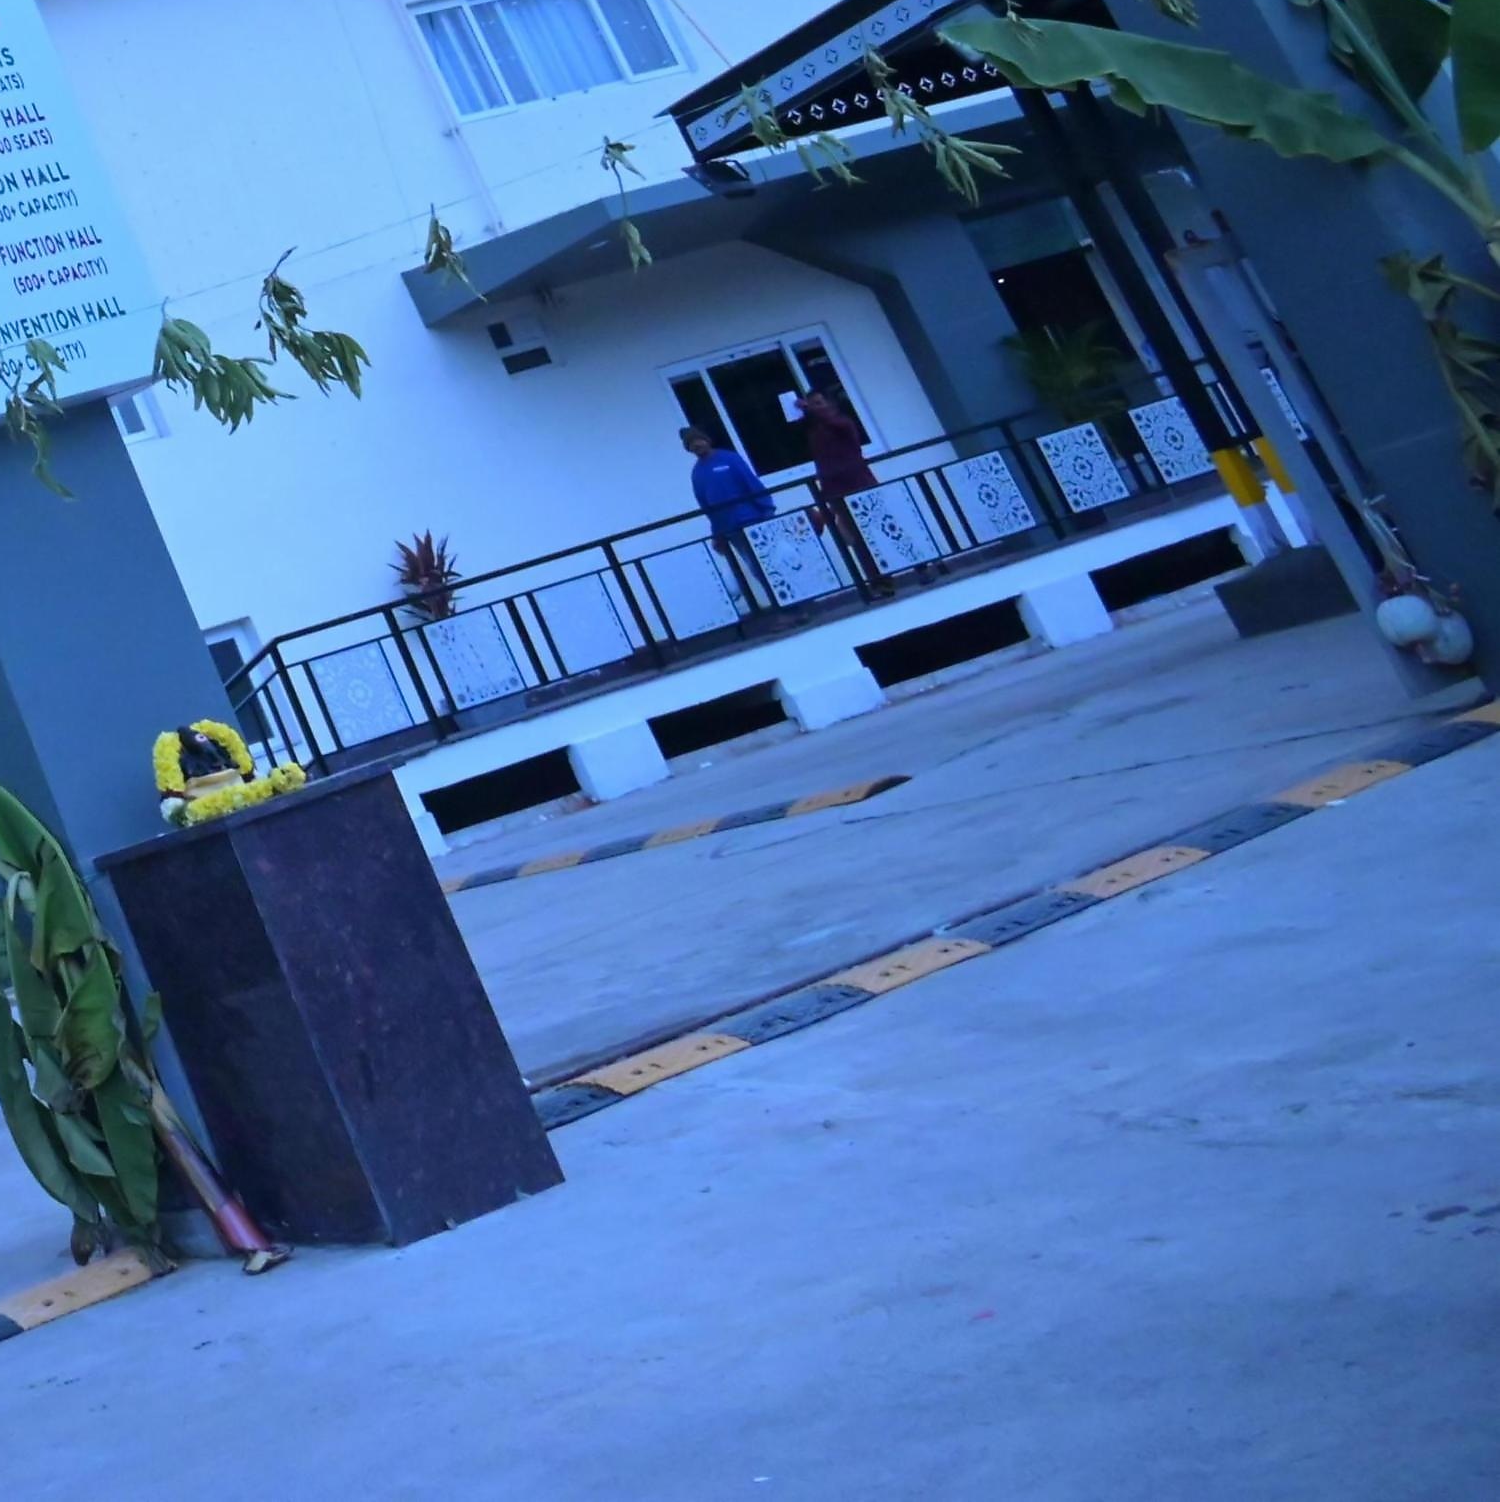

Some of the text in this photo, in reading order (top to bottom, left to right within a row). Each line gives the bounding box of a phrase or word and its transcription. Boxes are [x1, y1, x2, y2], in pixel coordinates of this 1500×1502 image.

[0, 102, 46, 129] HALL
[13, 127, 54, 152] SEATS)
[21, 162, 70, 188] HALL
[18, 189, 79, 218] CAPACITY)
[65, 225, 102, 250] HALL
[13, 257, 109, 295] (500+ CAPACITY)
[81, 296, 127, 324] HALL
[25, 340, 87, 371] CCITY)
